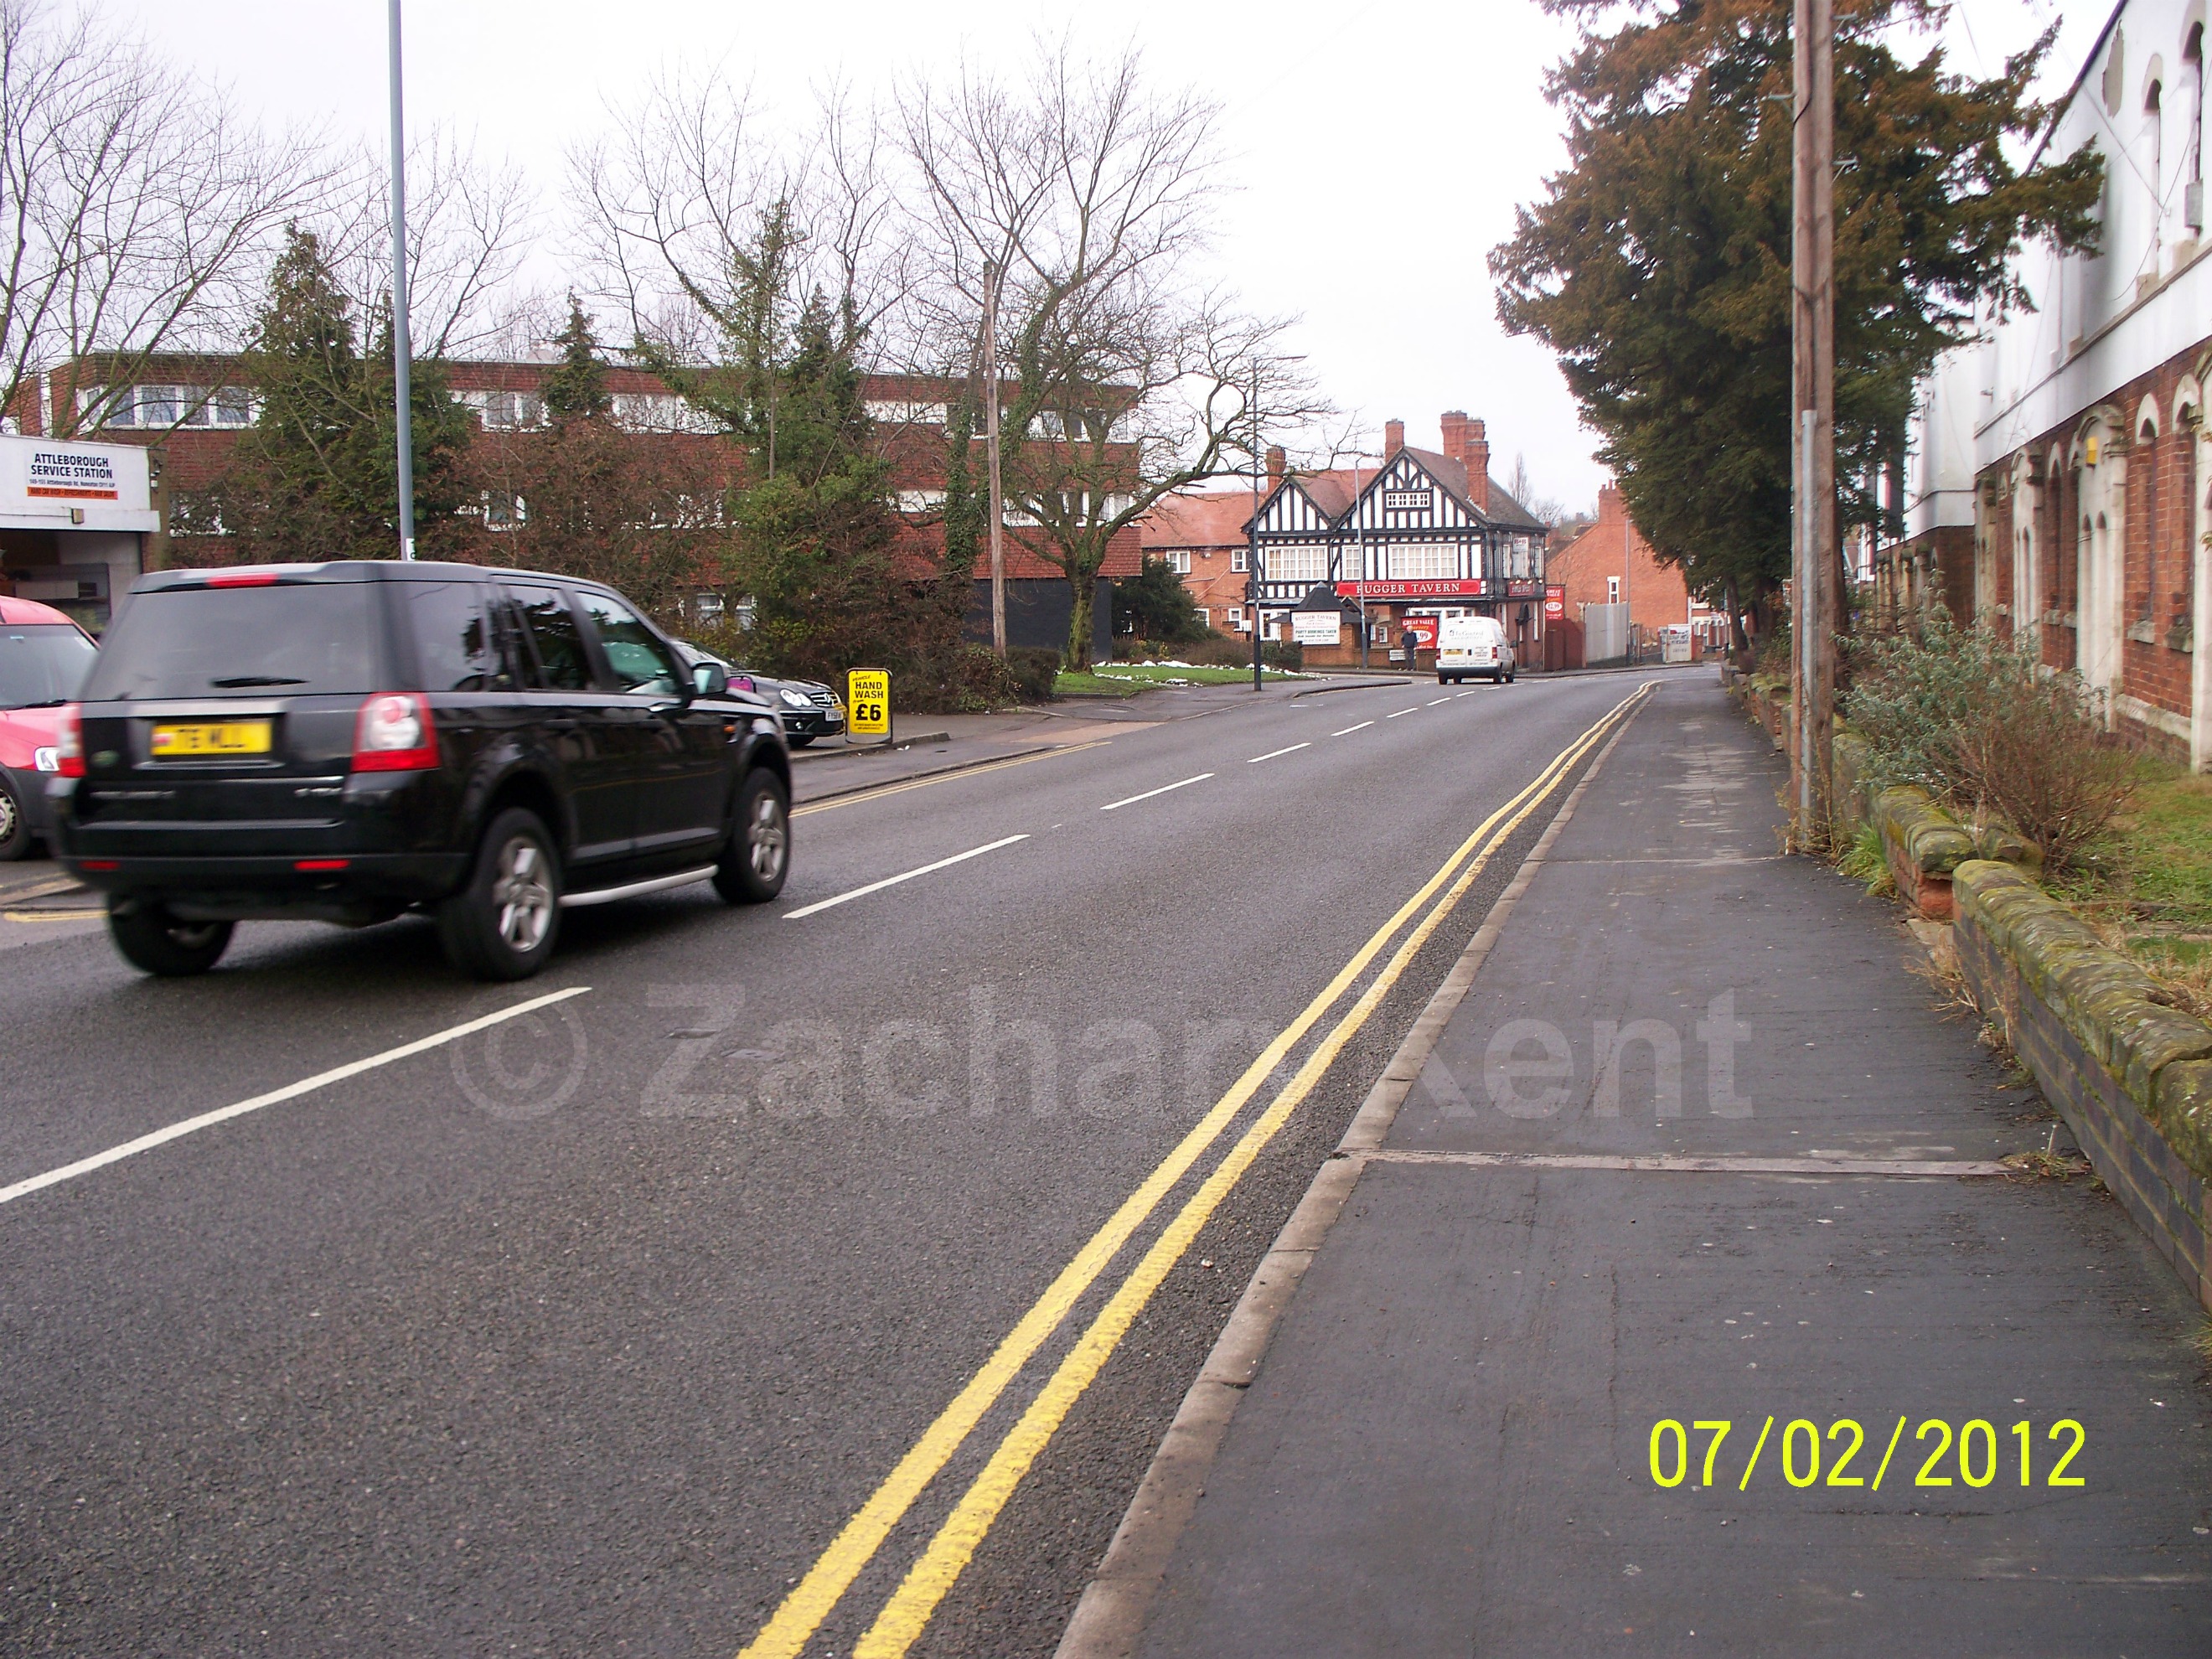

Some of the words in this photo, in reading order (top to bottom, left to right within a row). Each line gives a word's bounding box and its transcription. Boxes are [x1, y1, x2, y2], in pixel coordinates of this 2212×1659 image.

[34, 453, 109, 468] ATTLEBOROUGH
[30, 464, 71, 477] SERVICE
[74, 467, 113, 478] STATION
[1411, 583, 1460, 592] TAVERN
[855, 681, 882, 690] HAND
[855, 690, 884, 699] WASH
[855, 703, 881, 721] £6
